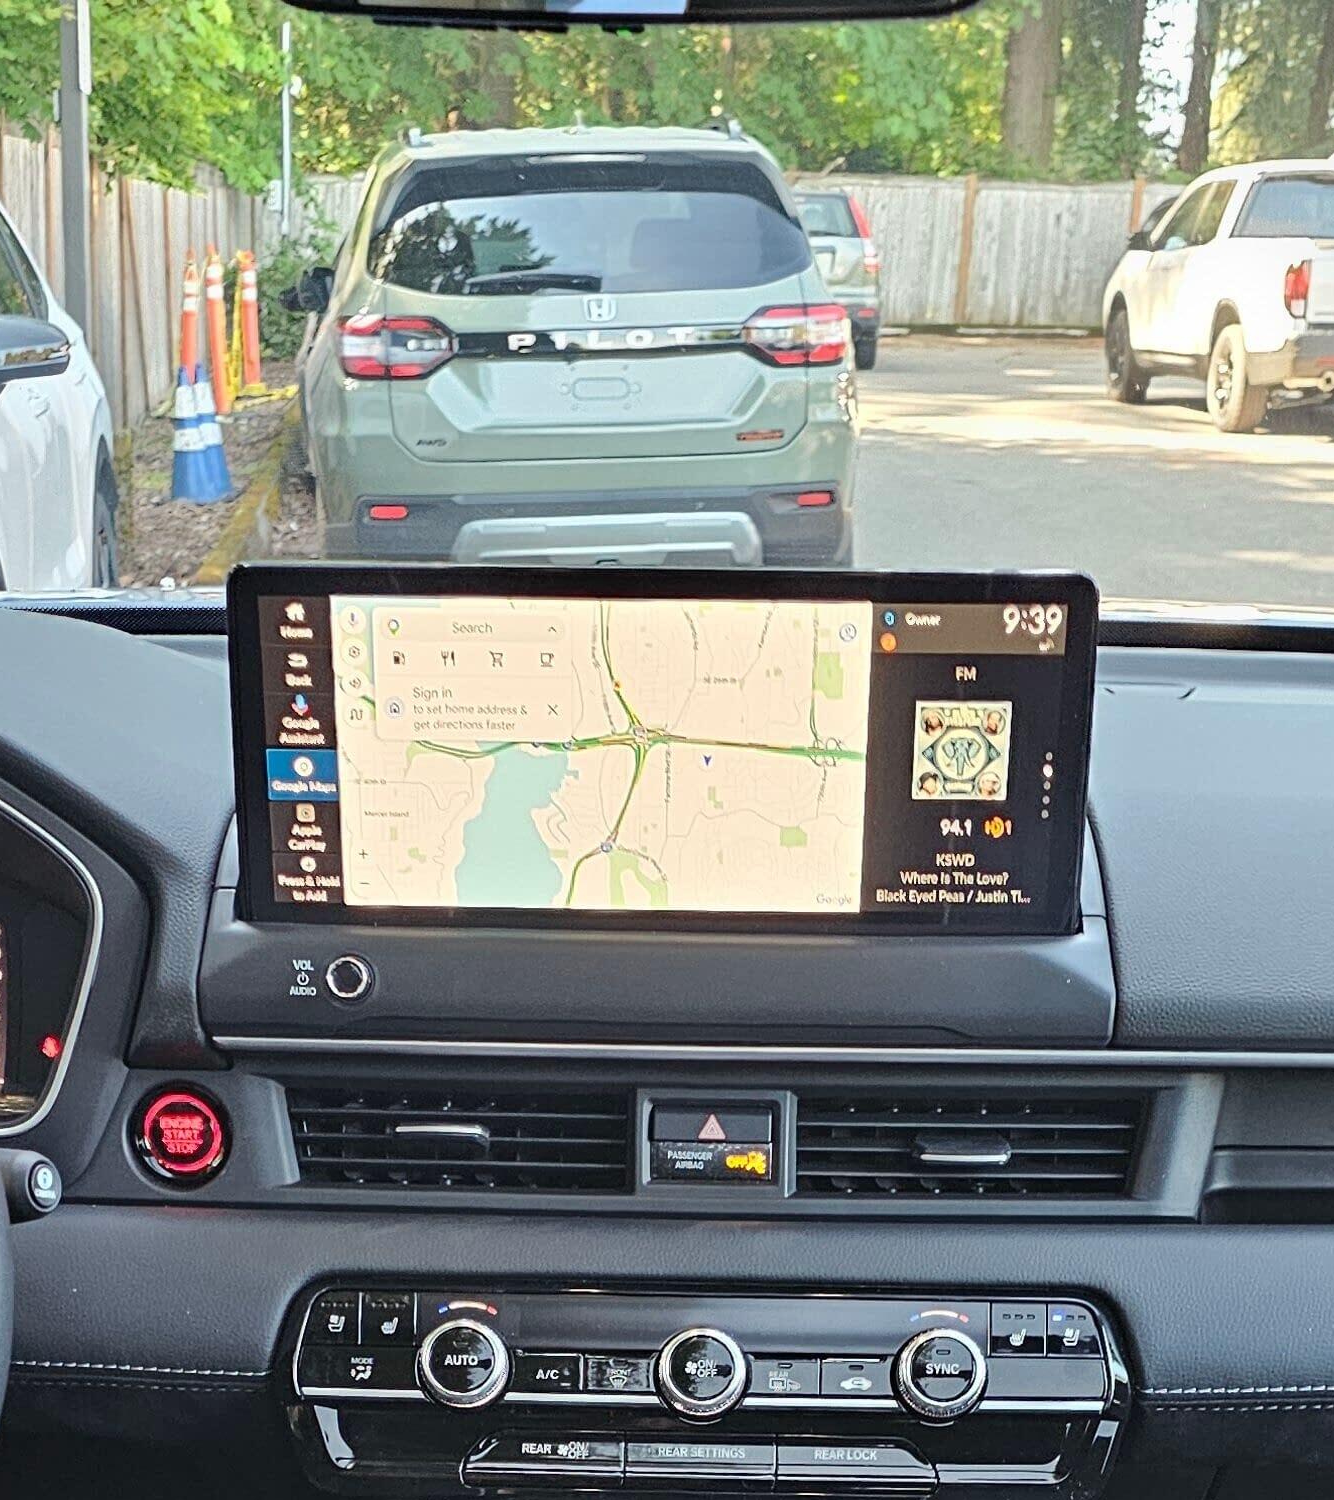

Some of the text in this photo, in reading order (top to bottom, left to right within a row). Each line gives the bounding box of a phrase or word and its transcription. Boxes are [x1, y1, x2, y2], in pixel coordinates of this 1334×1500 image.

[507, 327, 695, 352] PILOT
[905, 612, 941, 626] Owner
[1003, 604, 1063, 634] 9:39
[452, 622, 493, 634] Search
[955, 665, 977, 681] FM
[413, 687, 452, 701] Sign in
[413, 705, 528, 715] to set home address &
[413, 719, 515, 731] get directions faster
[271, 780, 308, 793] Google
[940, 819, 972, 836] 94.1
[936, 853, 975, 867] KSWD
[900, 871, 1009, 886] Where Is The Love?
[876, 890, 906, 903] Black
[909, 890, 937, 905] Eyed
[939, 890, 965, 904] Peas
[975, 890, 1009, 904] Justin
[293, 960, 314, 971] VOL
[289, 986, 317, 996] AUDIO
[159, 1115, 204, 1129] ENGINE
[163, 1130, 201, 1141] START
[166, 1143, 198, 1154] STOP
[667, 1151, 713, 1160] PASSENGER
[726, 1154, 748, 1168] OFF
[674, 1161, 704, 1170] AIRBAG
[351, 1357, 374, 1365] MODE
[443, 1355, 478, 1366] AUTO
[535, 1368, 560, 1380] A/C
[697, 1369, 718, 1378] OFF
[768, 1370, 789, 1379] REAR
[925, 1363, 960, 1375] SYNC
[521, 1442, 552, 1455] REAR
[658, 1446, 746, 1460] REAR SETTINGS
[568, 1450, 589, 1460] OFF
[815, 1449, 877, 1461] REAR LOCK
